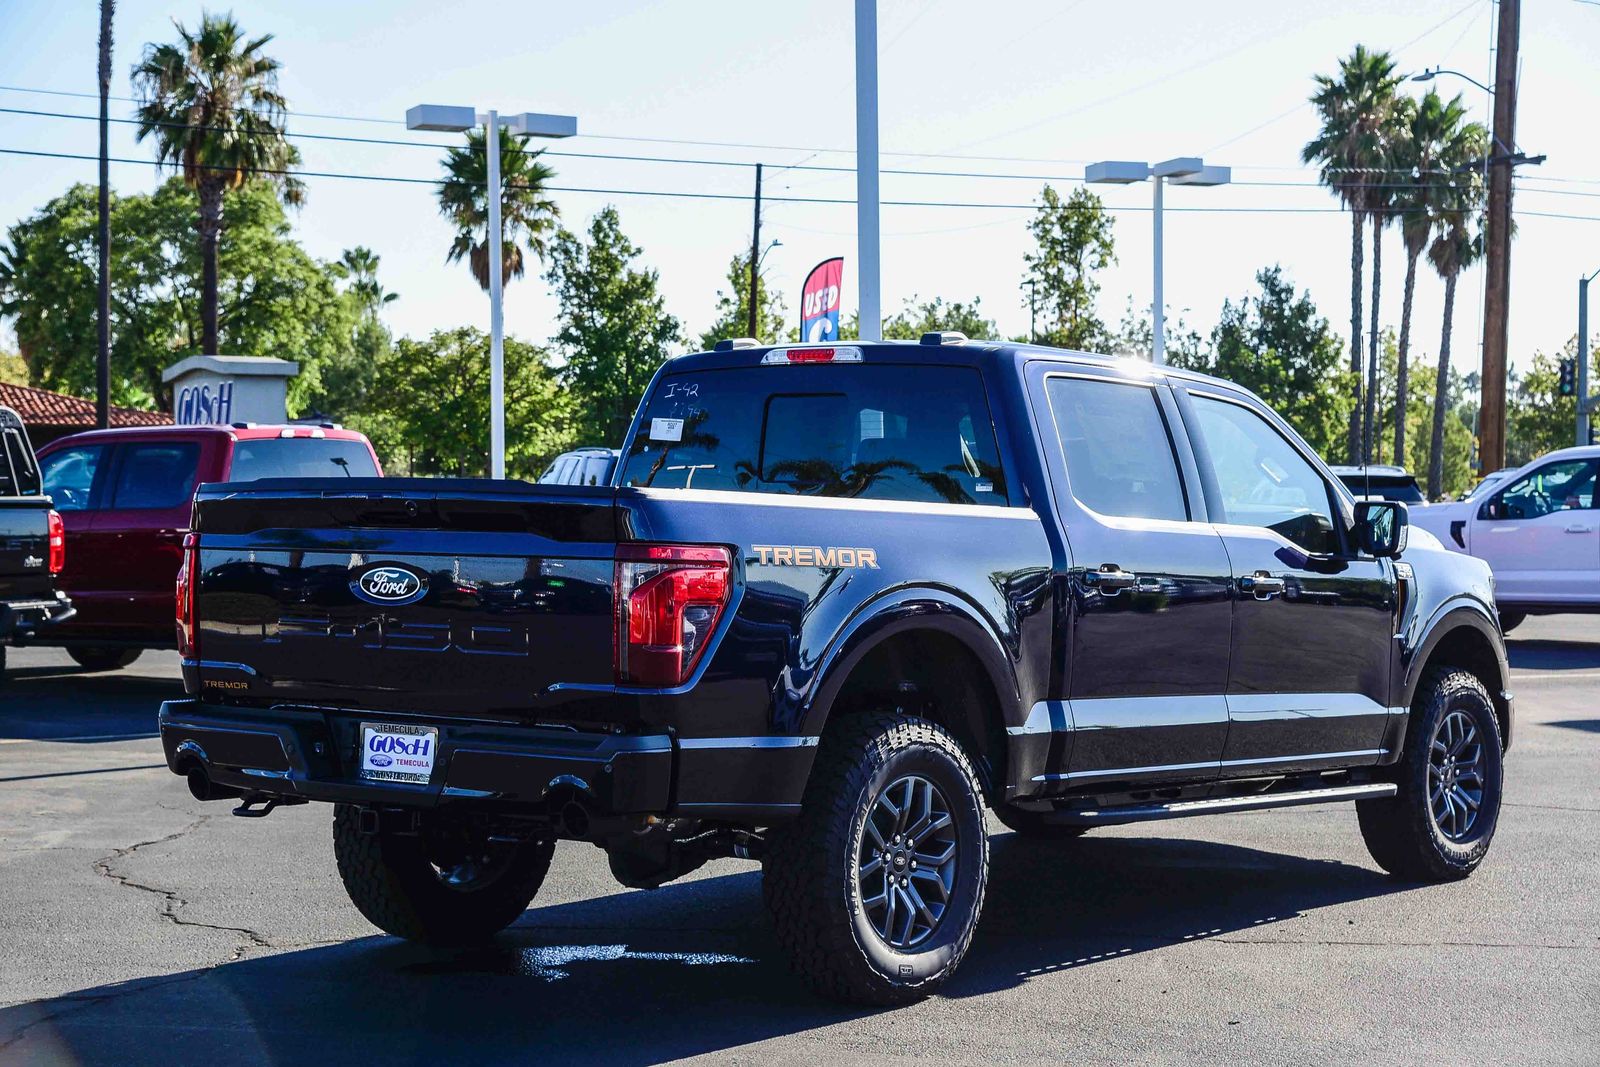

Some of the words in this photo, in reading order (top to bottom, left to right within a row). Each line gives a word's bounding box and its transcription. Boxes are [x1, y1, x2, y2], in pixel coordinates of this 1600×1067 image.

[805, 285, 838, 317] USED
[664, 382, 699, 398] I-42
[751, 544, 880, 569] TREMOR
[370, 571, 409, 594] Ford
[203, 680, 248, 689] TREMOR
[379, 724, 419, 735] TEMECULA
[395, 758, 430, 768] TEMECULA
